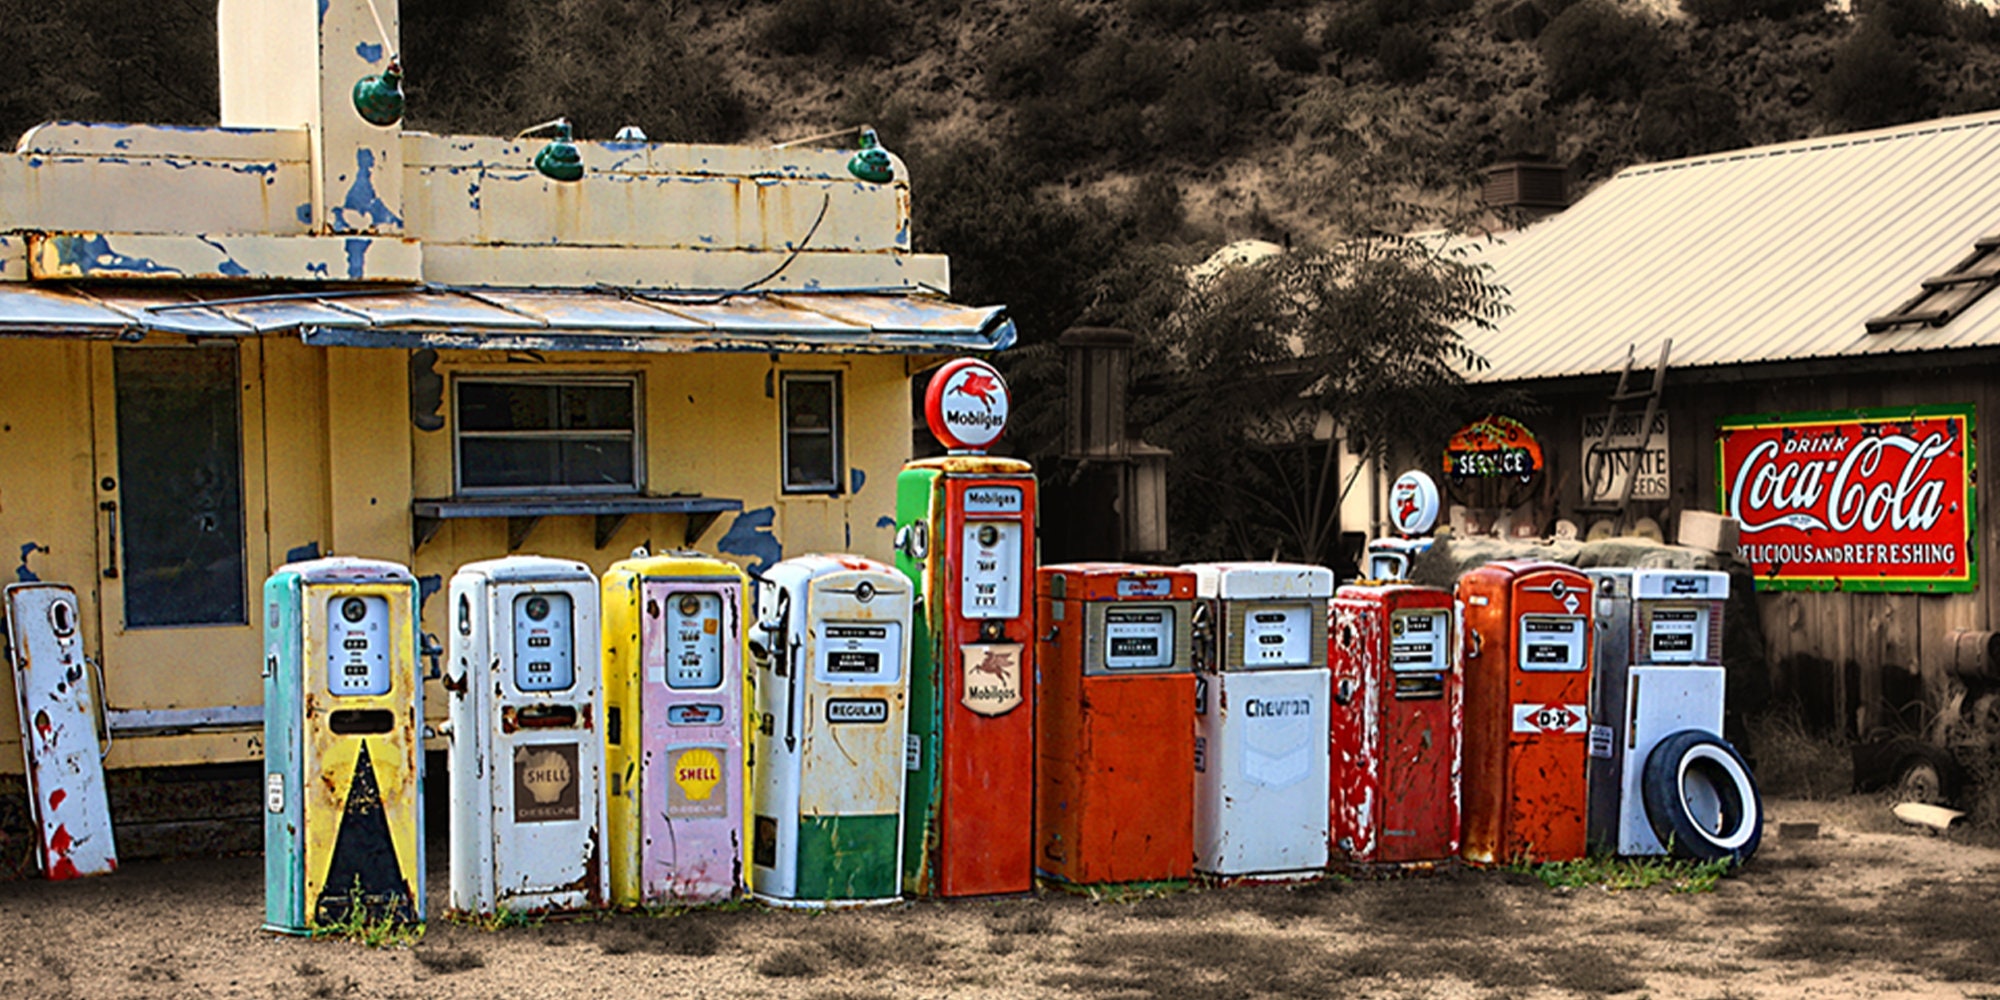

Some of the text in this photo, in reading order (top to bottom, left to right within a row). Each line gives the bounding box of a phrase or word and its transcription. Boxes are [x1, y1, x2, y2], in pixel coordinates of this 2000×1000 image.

[947, 410, 1003, 430] Mobilgas
[1585, 413, 1665, 437] DISTIBUTRS
[1783, 437, 1849, 454] DRINK
[1629, 477, 1667, 496] EEDS
[1730, 432, 1956, 532] Coca-Cola
[969, 492, 1016, 508] Mobilgas
[1844, 543, 1955, 564] REFRESHING
[968, 685, 1016, 704] Mobilgas
[832, 704, 882, 717] REGULAR
[1245, 698, 1310, 718] Chevron
[527, 768, 567, 784] SHELL
[679, 767, 717, 782] SHELL
